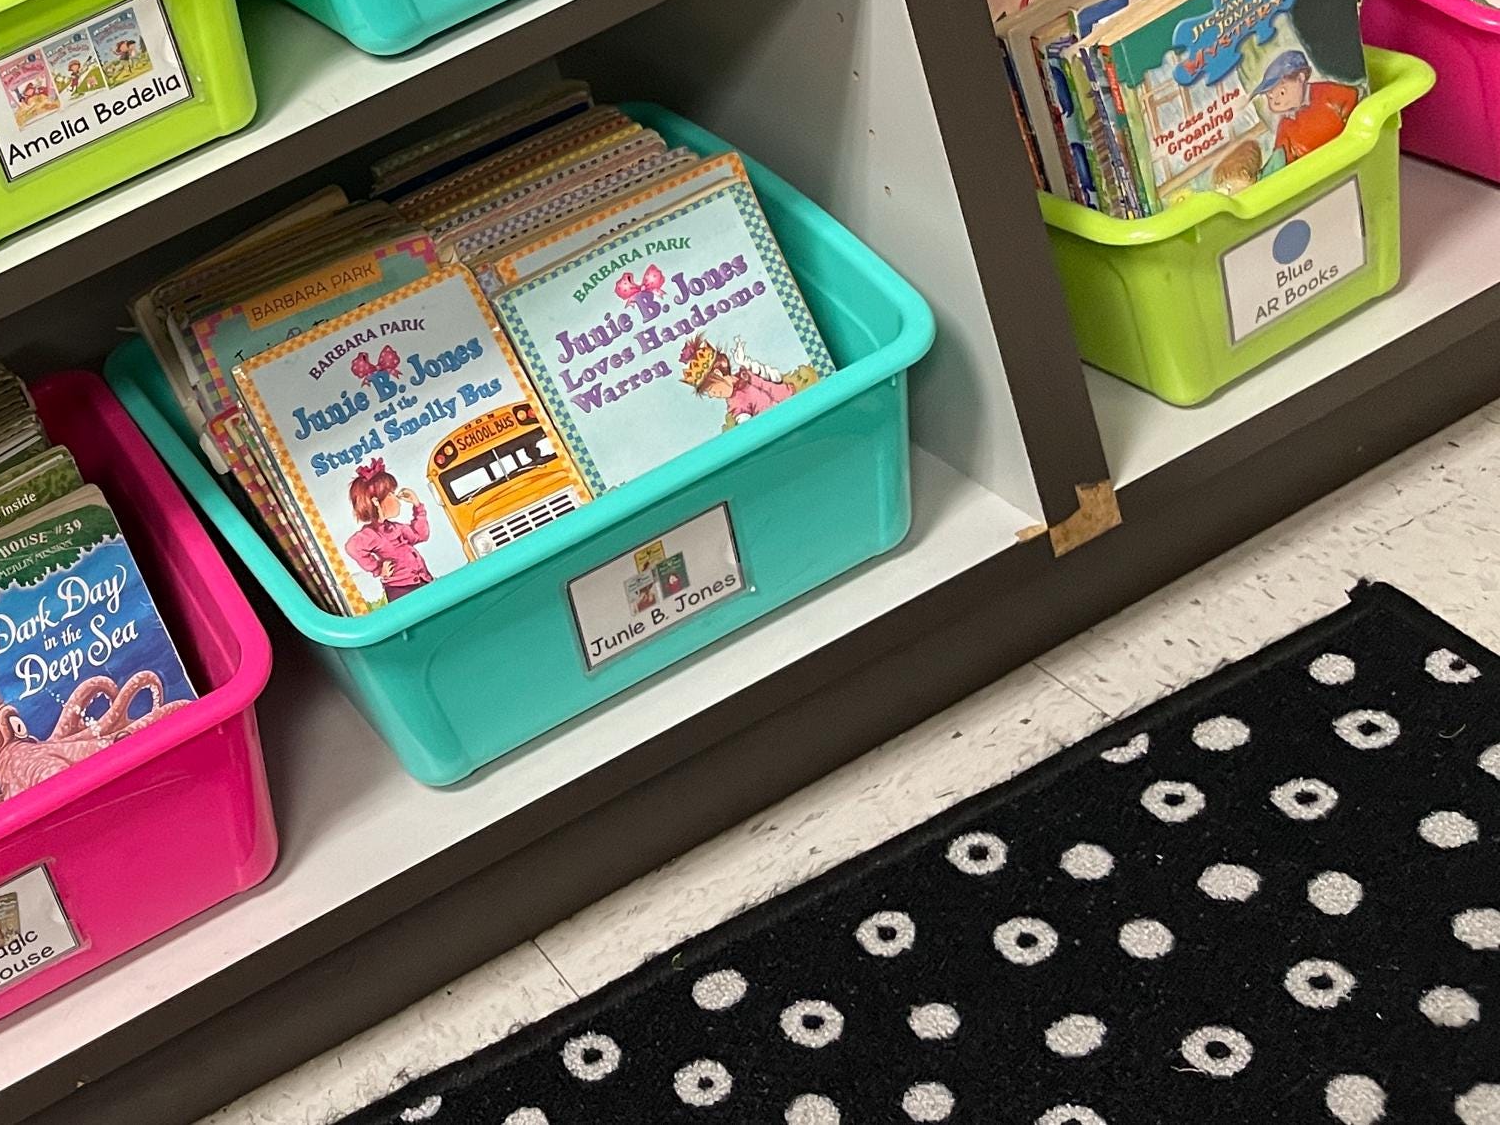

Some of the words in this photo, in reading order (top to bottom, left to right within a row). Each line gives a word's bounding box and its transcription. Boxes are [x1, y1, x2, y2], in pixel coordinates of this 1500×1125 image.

[8, 116, 90, 166] Amelia
[93, 74, 182, 125] Bedelia
[1167, 107, 1234, 155] Groaning
[1183, 129, 1224, 162] Ghost
[251, 280, 329, 323] BARBARA
[331, 262, 376, 290] PARK
[572, 247, 643, 304] BARBARA
[644, 236, 692, 265] PARK
[1255, 297, 1280, 324] AR
[1285, 265, 1339, 305] Books
[1276, 258, 1314, 288] Blue
[556, 311, 634, 364] Junie
[633, 290, 670, 324] B.
[671, 254, 749, 305] Jones
[558, 342, 635, 393] Loves
[633, 279, 767, 356] Handsome
[308, 328, 378, 382] BARBARA
[380, 318, 426, 336] PARK
[292, 389, 371, 441] Junie
[371, 371, 407, 405] B.
[407, 337, 484, 387] Jones
[571, 357, 673, 414] Warren
[310, 432, 384, 478] Stupid
[384, 397, 457, 442] Smelly
[456, 378, 503, 410] Bus
[456, 427, 494, 453] SCHOOL
[494, 416, 514, 436] BUS
[0, 491, 38, 518] inside
[0, 531, 48, 559] HOUSE
[55, 519, 82, 536] #39
[57, 564, 128, 617] Day
[590, 621, 646, 657] Junie
[651, 608, 669, 626] B.
[675, 573, 736, 613] Jones
[14, 652, 84, 701] Deep
[87, 615, 139, 667] Sea
[43, 634, 59, 652] in
[61, 626, 82, 646] the
